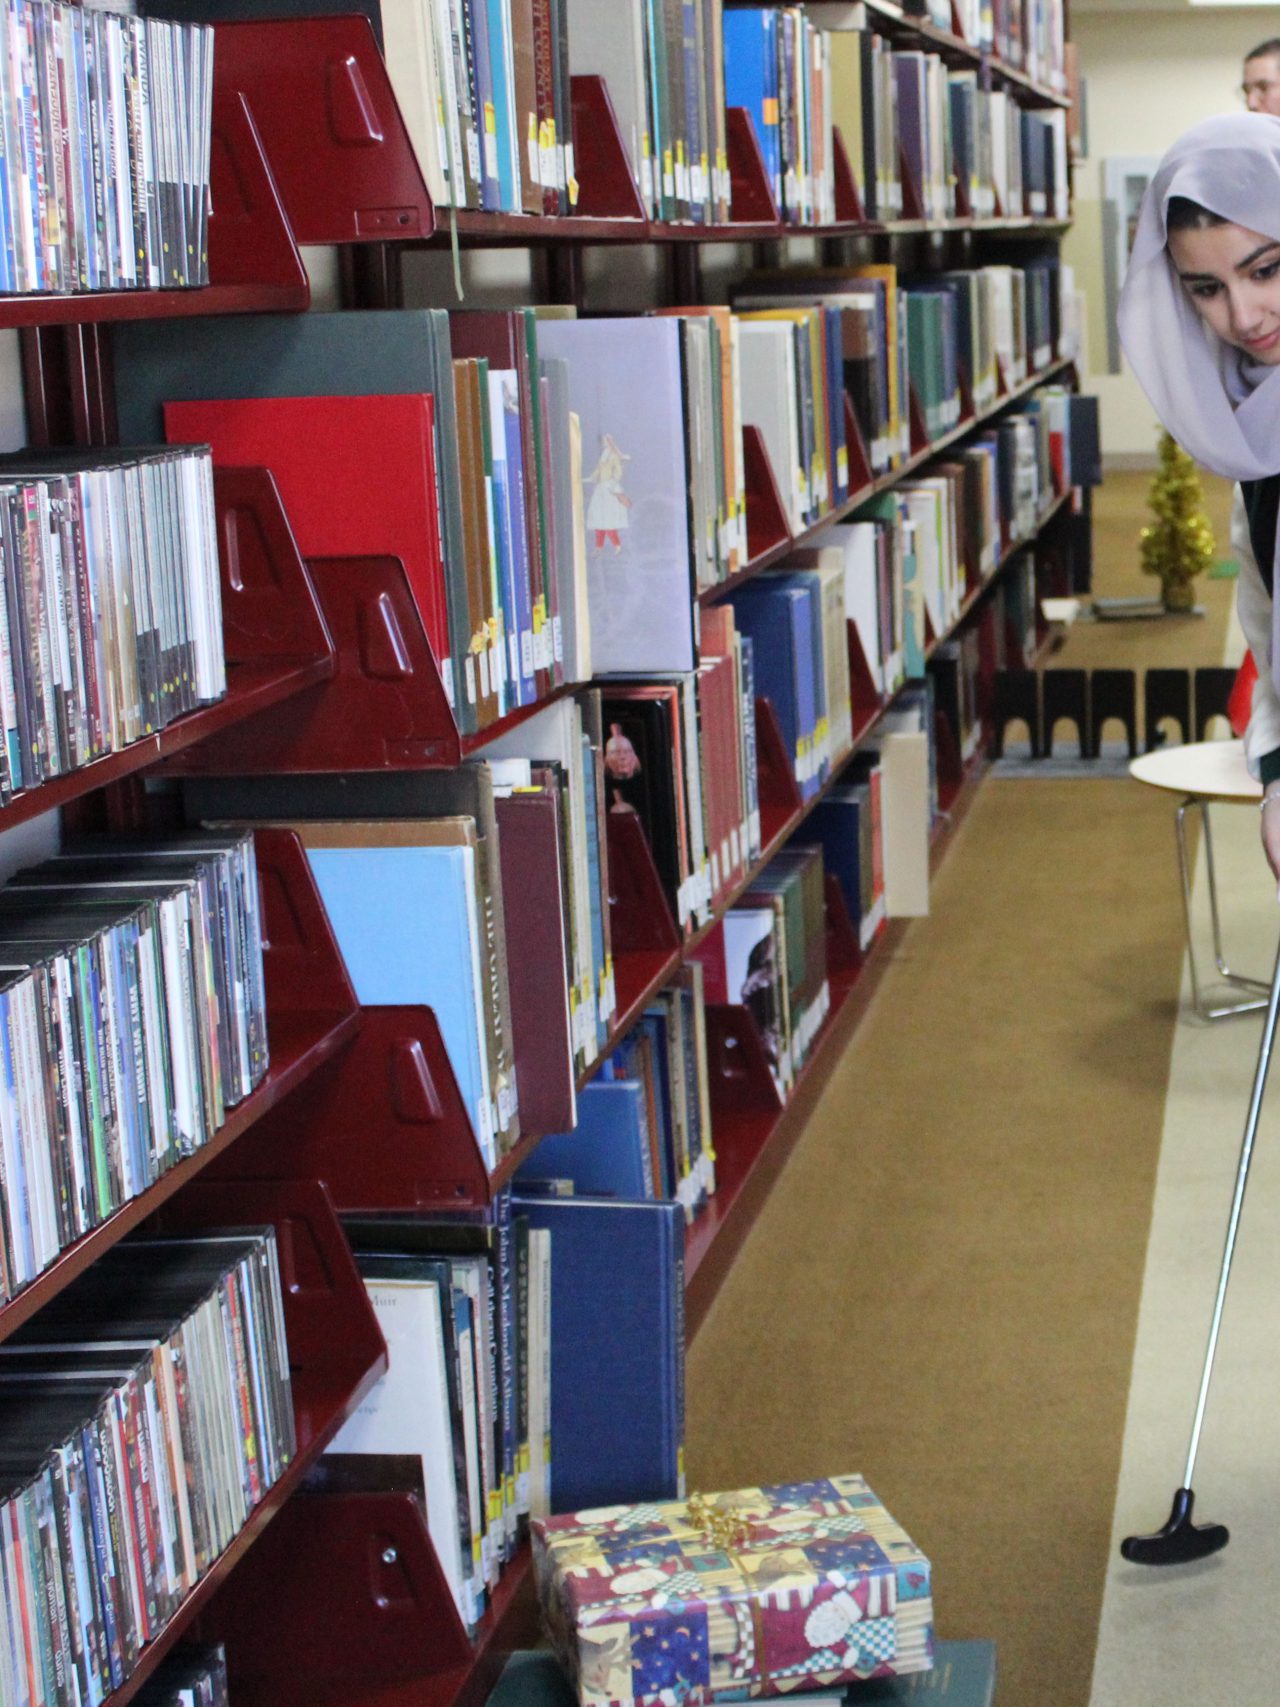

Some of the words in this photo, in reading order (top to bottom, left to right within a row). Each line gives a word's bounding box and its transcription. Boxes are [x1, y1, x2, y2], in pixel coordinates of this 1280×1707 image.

[139, 38, 149, 105] WANDA
[130, 160, 140, 229] DISNEY
[490, 953, 502, 1037] GREAT
[500, 1193, 511, 1222] The
[498, 1226, 510, 1262] John
[488, 1300, 496, 1338] them
[502, 1286, 511, 1371] Macdonald
[490, 1342, 498, 1422] Canadians
[504, 1375, 512, 1430] Album
[137, 1431, 149, 1483] WORLD
[47, 1579, 57, 1623] woman
[55, 1650, 65, 1688] dunes
